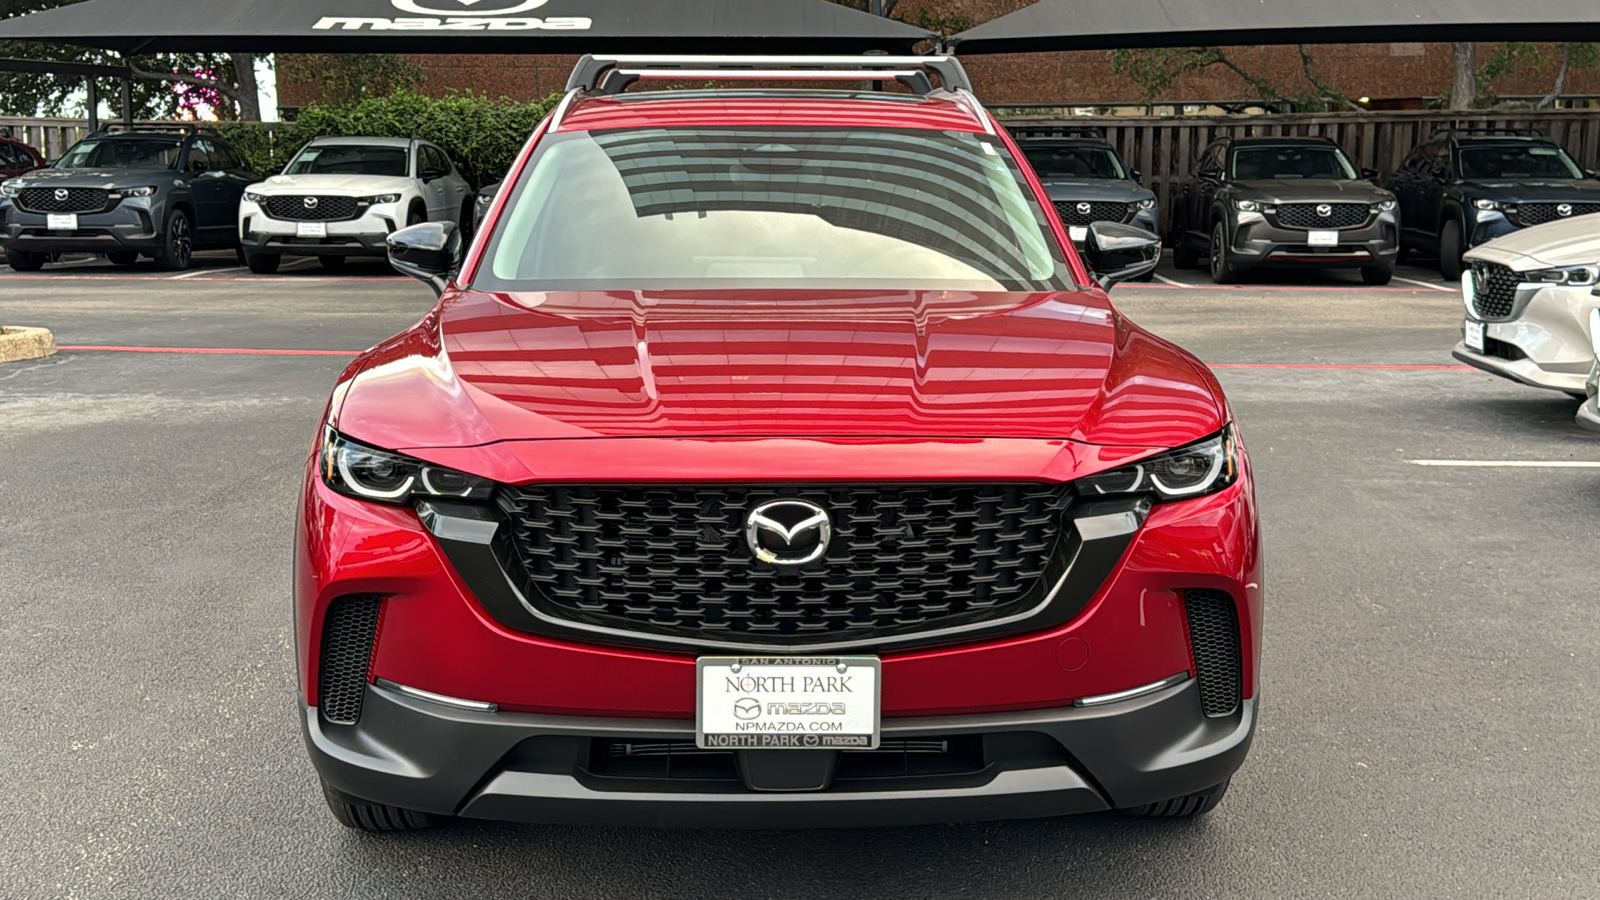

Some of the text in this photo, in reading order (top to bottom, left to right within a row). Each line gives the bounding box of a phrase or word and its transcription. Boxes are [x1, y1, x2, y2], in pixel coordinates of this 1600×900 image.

[311, 16, 592, 31] mazda
[725, 675, 853, 693] NORTH PARK
[767, 702, 846, 715] mazda
[735, 722, 843, 731] NPMAZDA.COM
[708, 735, 868, 746] NORTH PARK mazda
